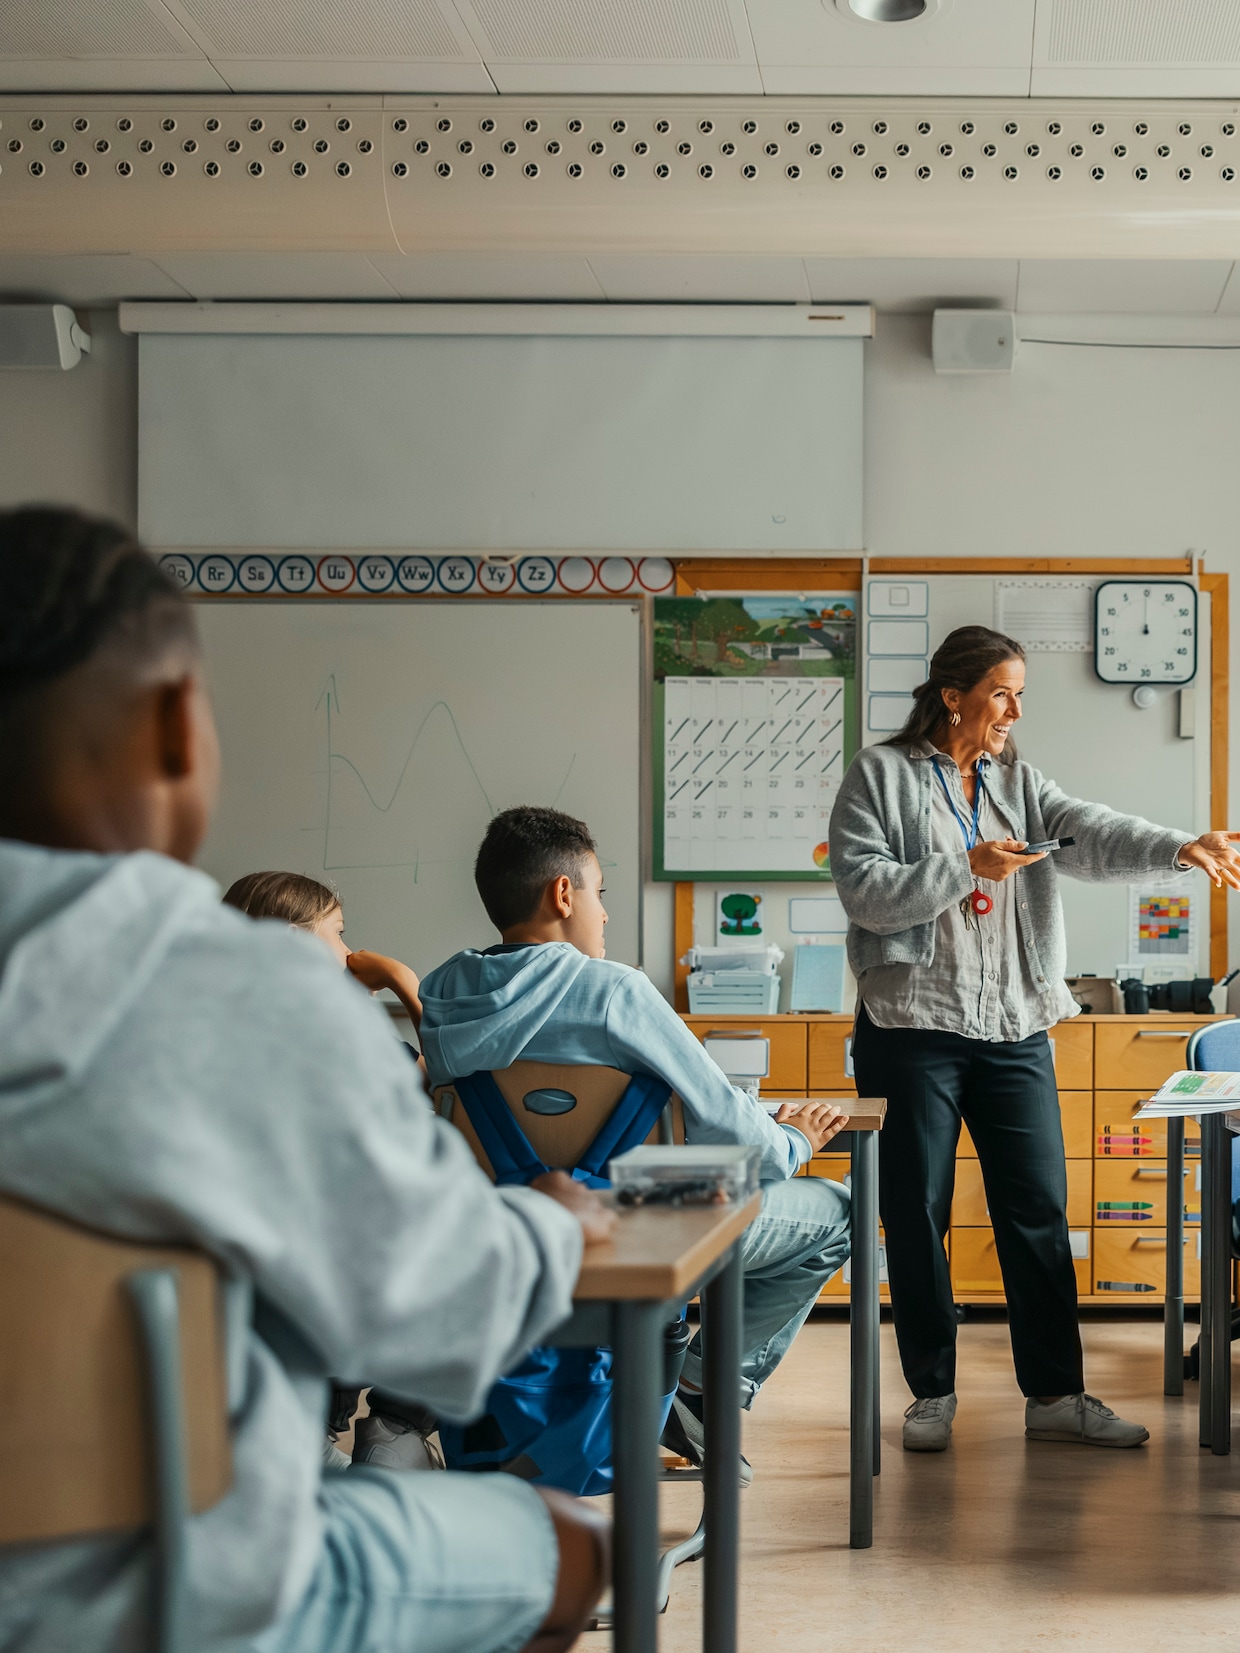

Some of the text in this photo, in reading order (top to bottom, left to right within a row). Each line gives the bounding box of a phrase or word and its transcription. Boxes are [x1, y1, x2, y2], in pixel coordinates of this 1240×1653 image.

[208, 566, 225, 581] Rr
[248, 566, 265, 581] Ss
[287, 566, 305, 581] Tt
[328, 565, 346, 580] Uu
[367, 565, 386, 580] Vv
[402, 566, 430, 581] Ww
[448, 566, 465, 581] Xx
[487, 566, 506, 583] Yy
[528, 566, 546, 581] Zz
[1165, 594, 1174, 602] 55
[1107, 608, 1115, 616] 10
[1179, 609, 1189, 617] 50
[1101, 627, 1109, 636] 15
[1183, 628, 1192, 636] 45
[1104, 647, 1115, 655] 20
[1177, 647, 1187, 655] 40
[1117, 663, 1127, 671] 25
[1141, 669, 1151, 677] 30
[692, 811, 702, 819] 26
